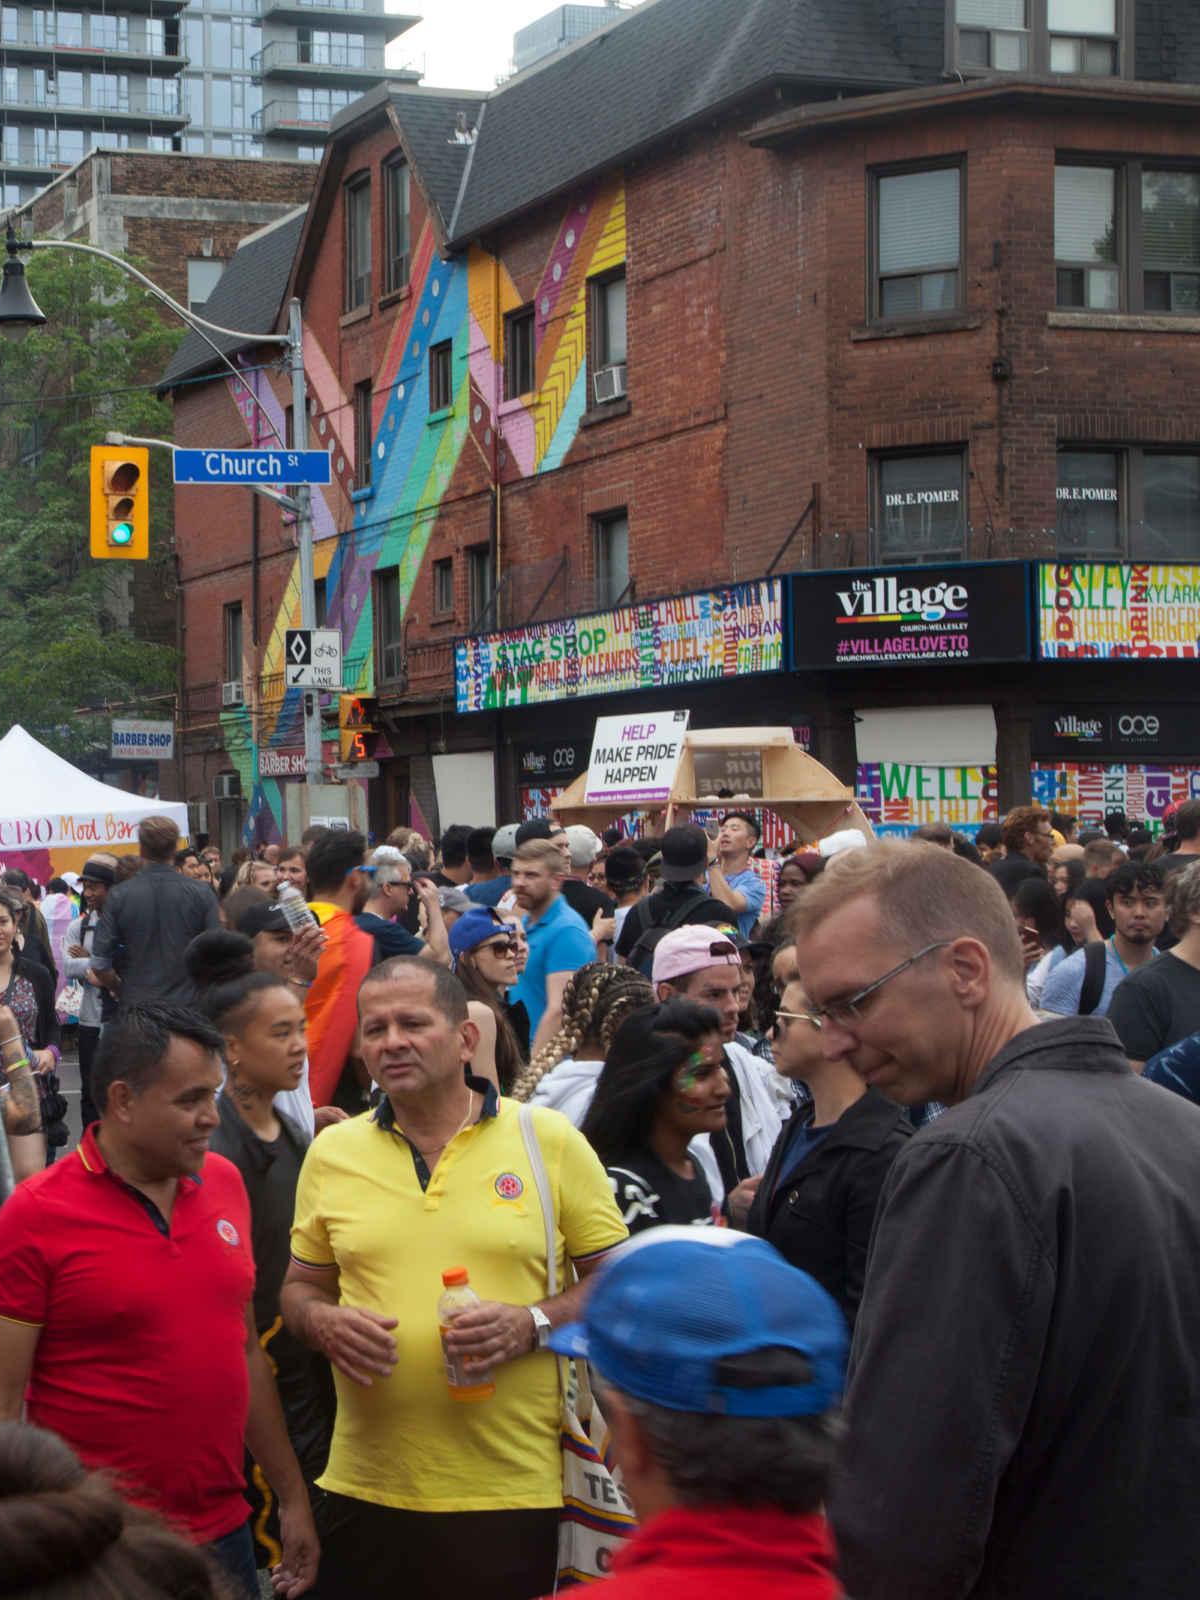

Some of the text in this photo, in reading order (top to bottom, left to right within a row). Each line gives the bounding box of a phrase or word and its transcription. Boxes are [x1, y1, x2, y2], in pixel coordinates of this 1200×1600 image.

[205, 453, 299, 476] Church St
[886, 489, 959, 506] DR. E. POMER
[1056, 487, 1117, 501] DR. E. POMER
[851, 579, 871, 592] the
[1041, 564, 1133, 610] LSLEY
[835, 576, 968, 622] village
[1055, 564, 1074, 639] DOG
[900, 622, 968, 633] CHURCH-WELLESLEY
[497, 638, 545, 664] STAG
[549, 627, 607, 661] SHOP
[836, 634, 969, 655] #VILLAGELOVETO
[835, 650, 948, 663] CHURCHWELLESLEYVILLAGE.CA
[311, 676, 333, 685] LANE
[313, 666, 333, 676] THIS
[620, 723, 657, 741] HELP
[1054, 715, 1102, 736] village
[113, 732, 171, 747] BARBER SHOP
[354, 732, 366, 758] 5
[593, 743, 677, 765] MAKE PRIDE
[259, 755, 290, 774] BARBER
[603, 765, 658, 784] HAPPEN
[59, 814, 101, 842] Mod
[104, 812, 139, 842] Bar
